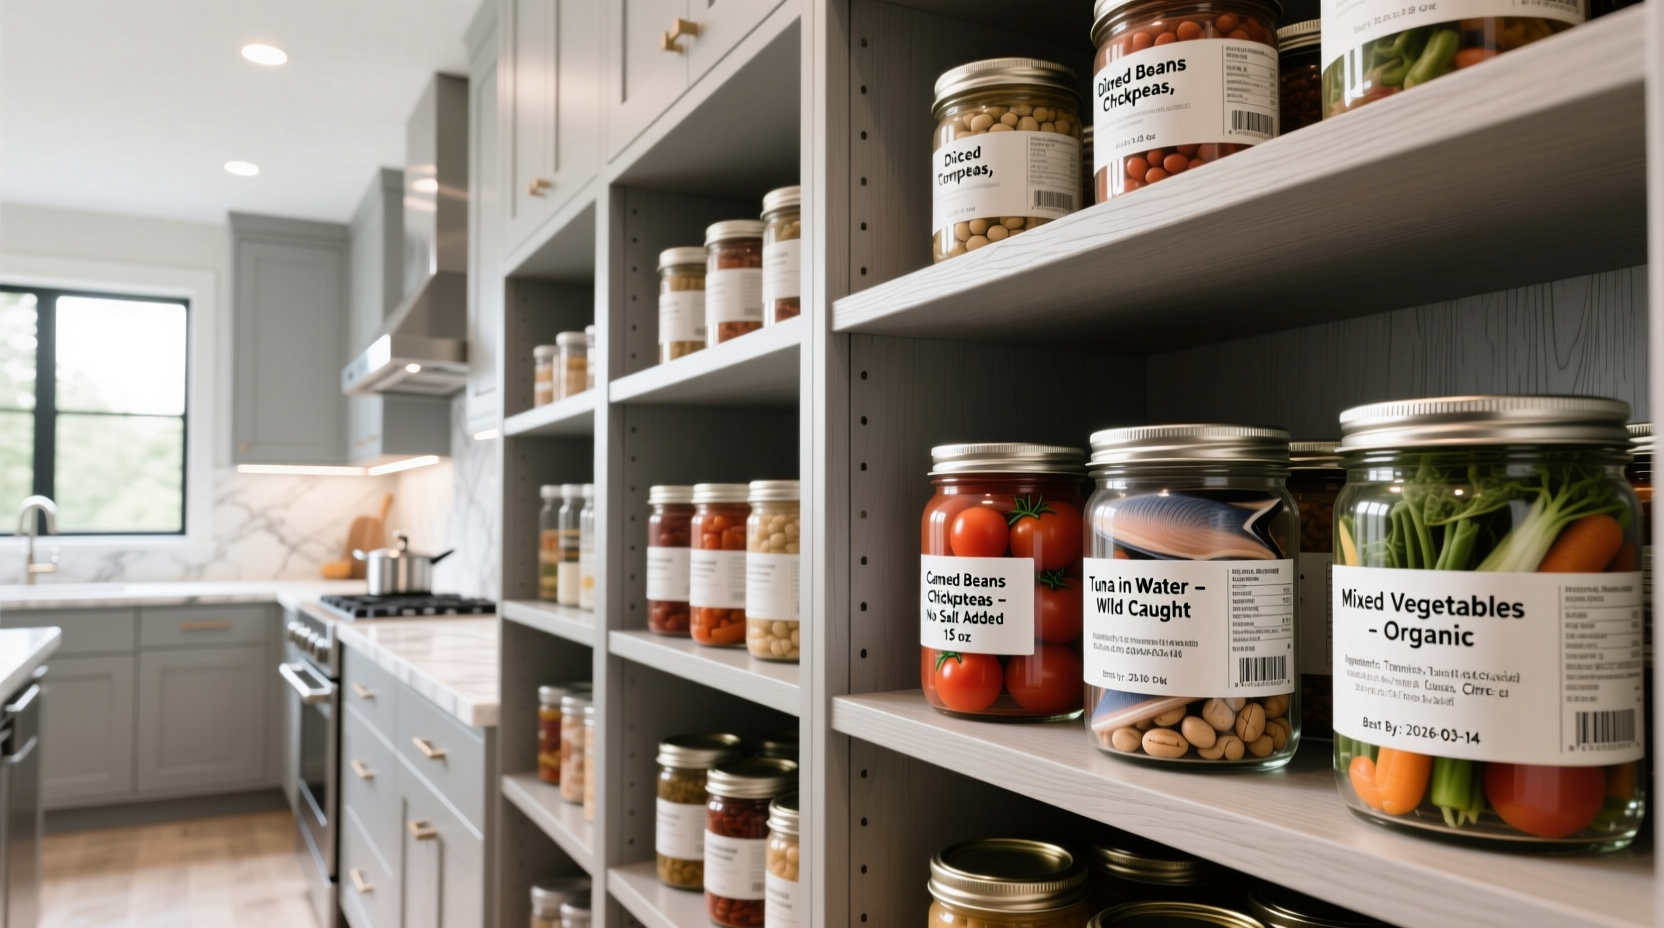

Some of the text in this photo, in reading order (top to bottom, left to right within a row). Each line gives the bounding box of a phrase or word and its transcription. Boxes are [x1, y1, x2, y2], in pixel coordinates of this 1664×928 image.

[1135, 58, 1187, 81] Beans
[963, 573, 1006, 588] Beans
[1088, 576, 1115, 593] Tuna
[1118, 576, 1132, 594] in
[1135, 577, 1189, 595] Water
[1128, 600, 1191, 622] Caught
[1342, 588, 1525, 620] Mixed Vegetables
[926, 608, 937, 622] No
[963, 611, 1004, 625] Added
[943, 628, 972, 643] 15 oz
[1383, 620, 1475, 649] Organic
[1362, 716, 1481, 745] Best By: 2026-03-14
